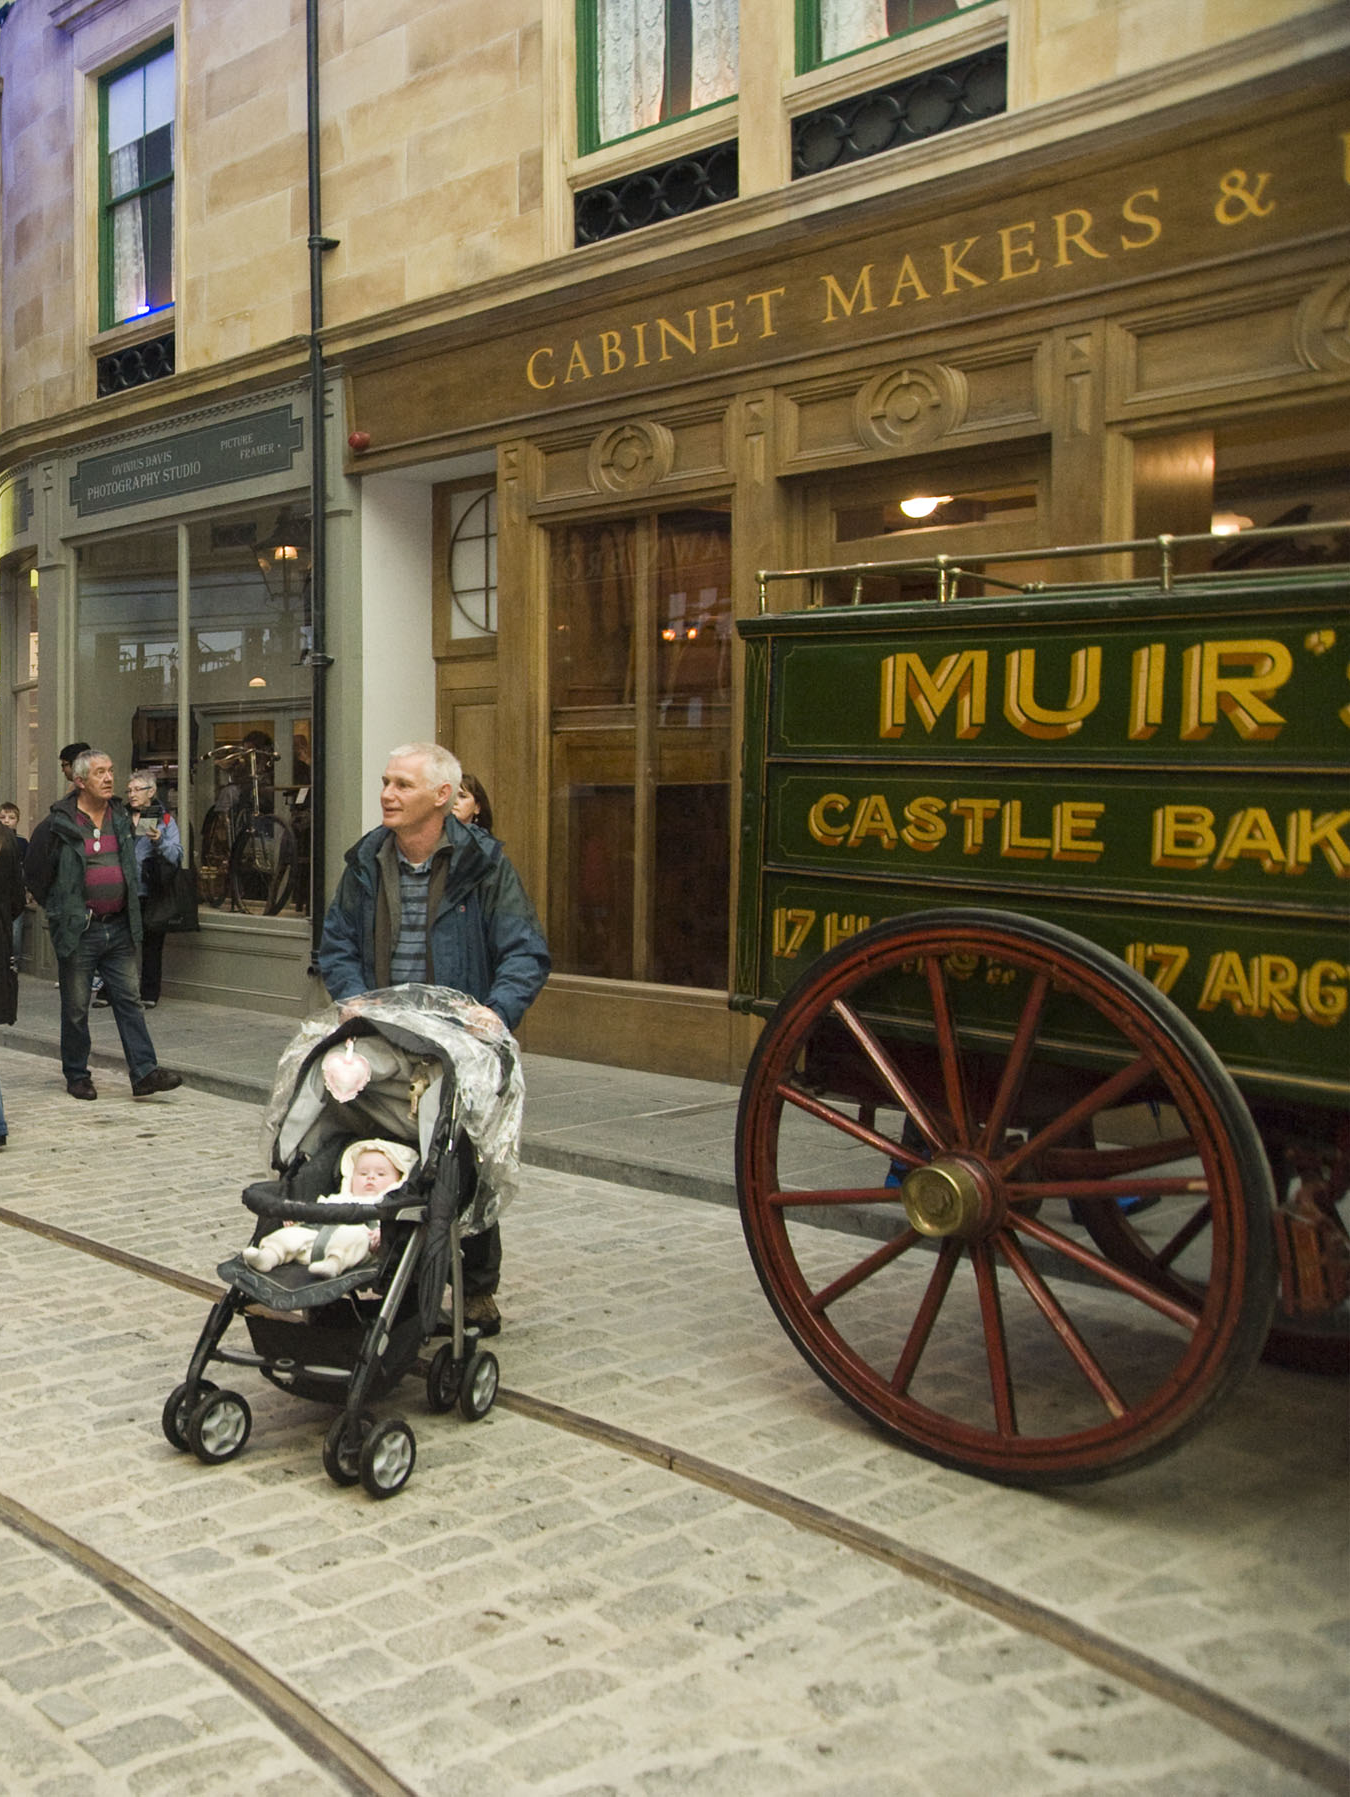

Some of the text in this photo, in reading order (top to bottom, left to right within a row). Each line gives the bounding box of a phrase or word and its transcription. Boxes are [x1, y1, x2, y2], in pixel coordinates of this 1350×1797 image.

[526, 168, 1276, 390] CABINET MAKERS &
[145, 450, 172, 468] DAVIS
[220, 433, 254, 451] PICTURE
[239, 442, 275, 461] FRAMER
[87, 460, 201, 501] PHOTOGRAPHY STUDIO
[879, 628, 1350, 742] MUIR'
[807, 792, 1106, 863] CASTLE
[771, 907, 817, 959] 17
[1125, 942, 1350, 1027] 17 ARG
